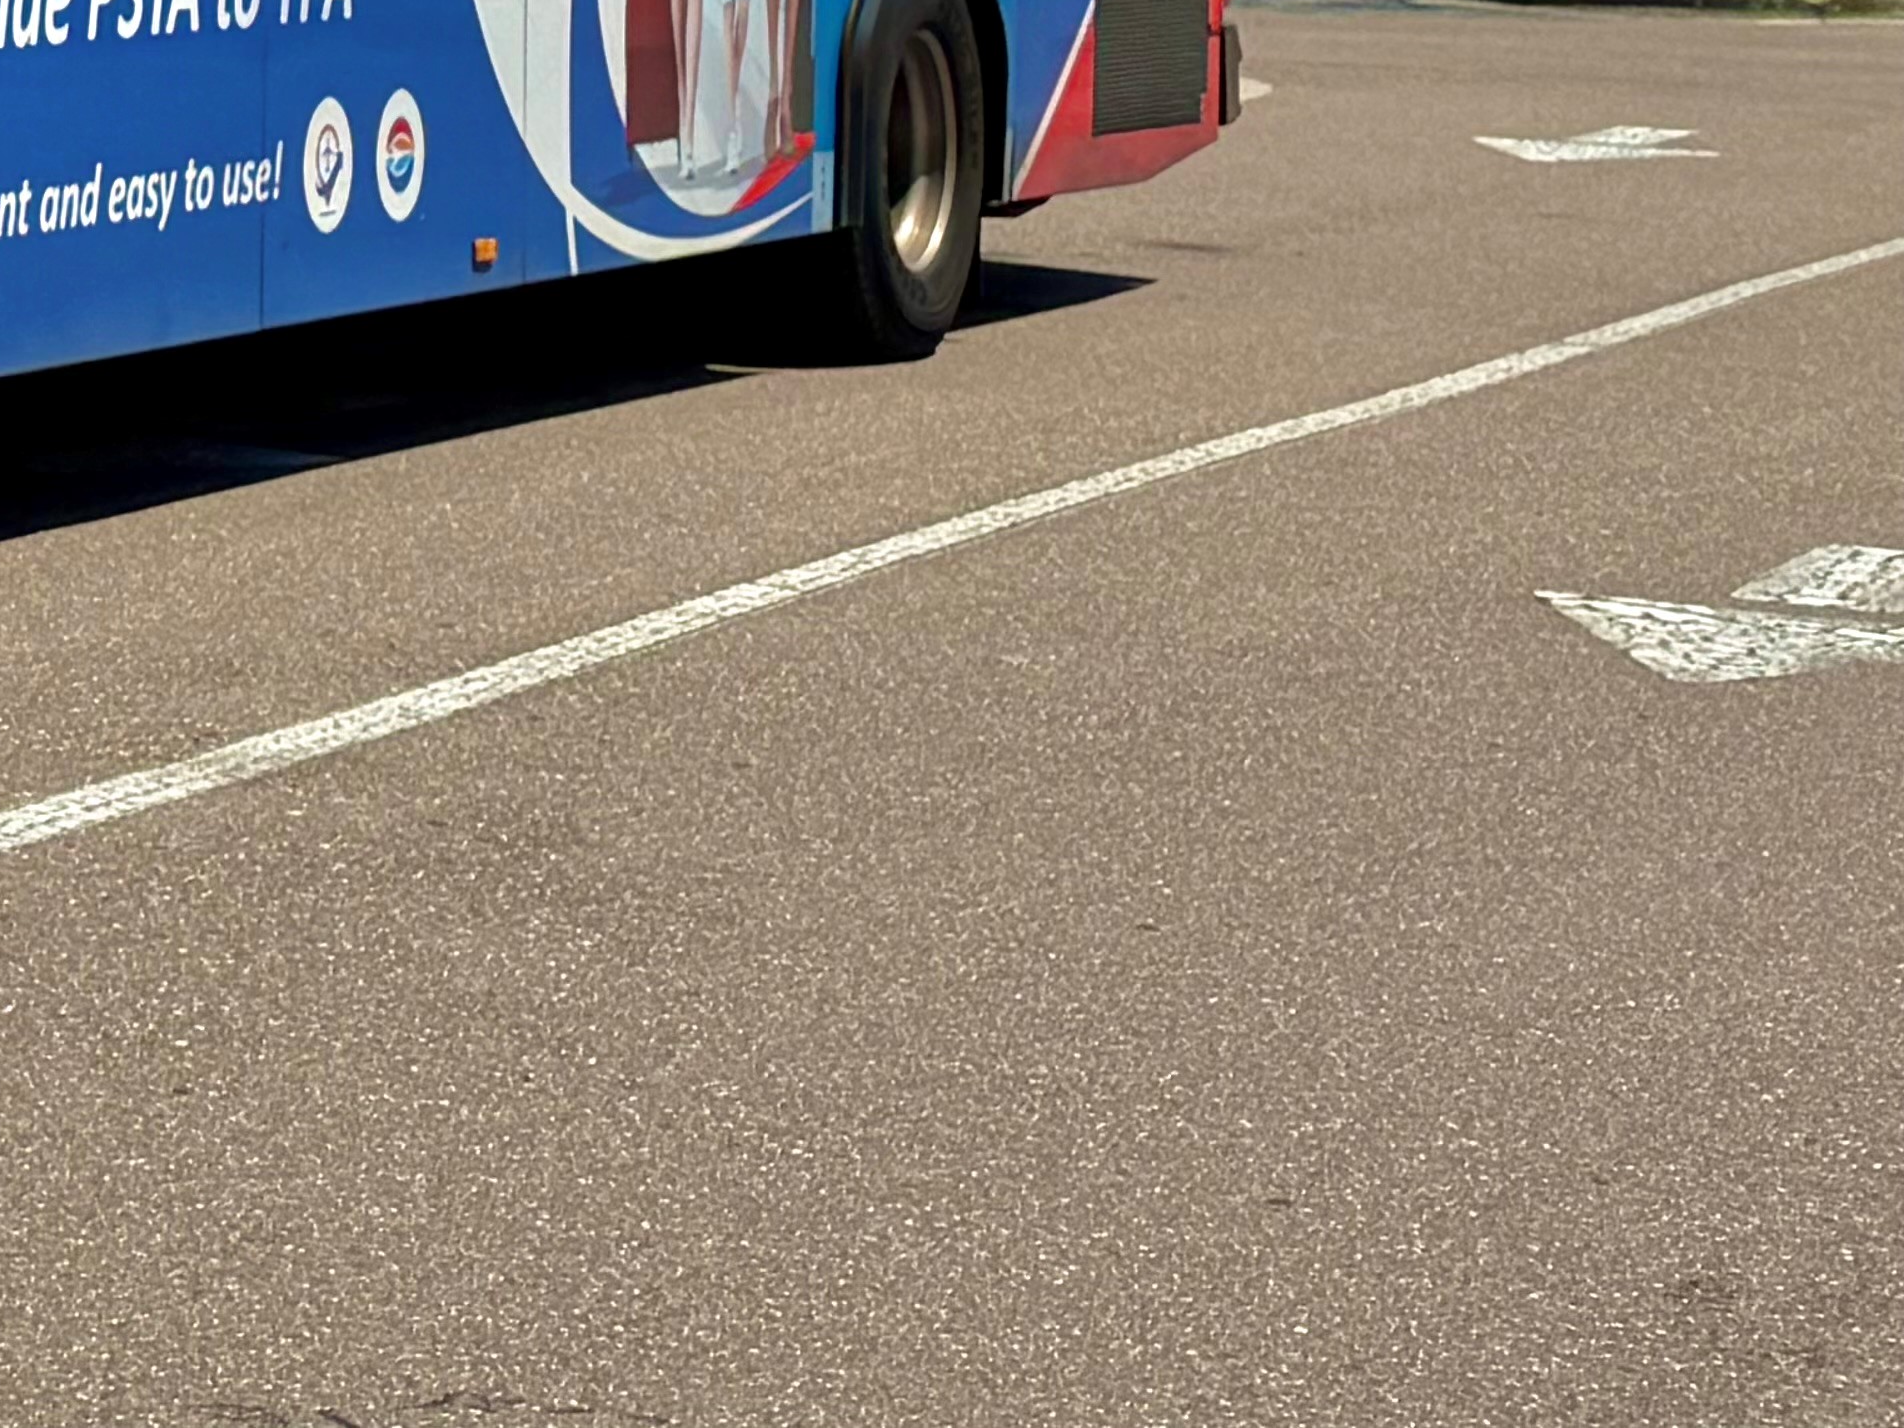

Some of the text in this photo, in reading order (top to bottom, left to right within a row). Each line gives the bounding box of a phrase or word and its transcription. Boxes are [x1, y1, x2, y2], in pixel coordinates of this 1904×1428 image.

[39, 161, 103, 234] and
[108, 169, 178, 232] easy
[184, 157, 215, 212] to
[222, 140, 284, 206] use!
